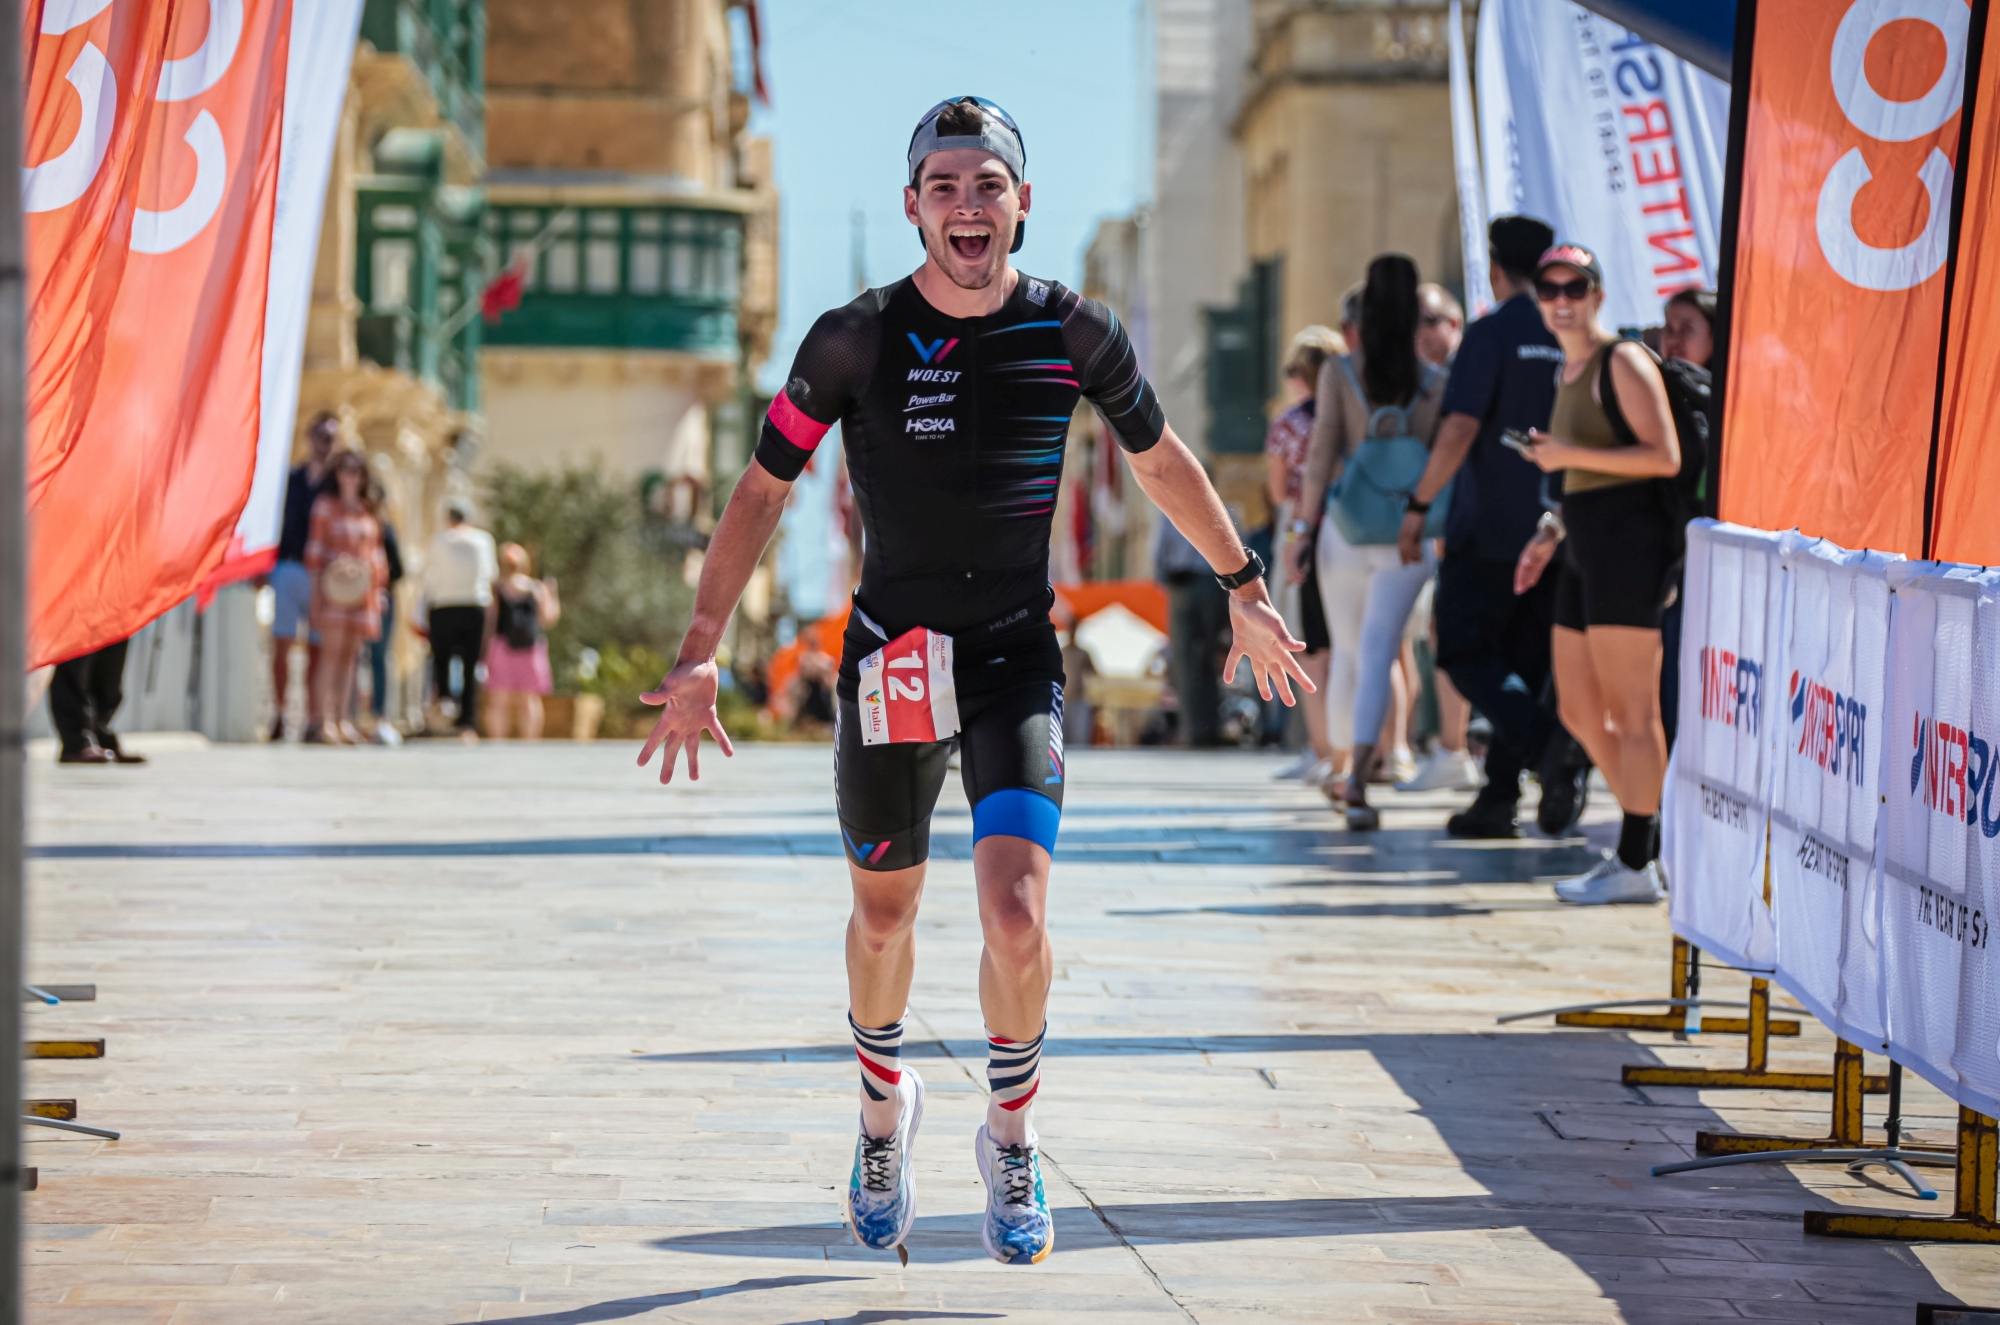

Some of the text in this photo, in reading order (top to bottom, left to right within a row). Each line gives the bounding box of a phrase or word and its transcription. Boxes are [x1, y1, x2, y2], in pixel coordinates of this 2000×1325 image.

[907, 369, 962, 383] WOEST
[908, 392, 957, 407] PowerBar
[905, 418, 955, 433] HOKA
[989, 608, 1029, 632] HUUB
[887, 649, 925, 702] 12
[871, 706, 882, 733] Malta
[1957, 904, 1968, 944] OF
